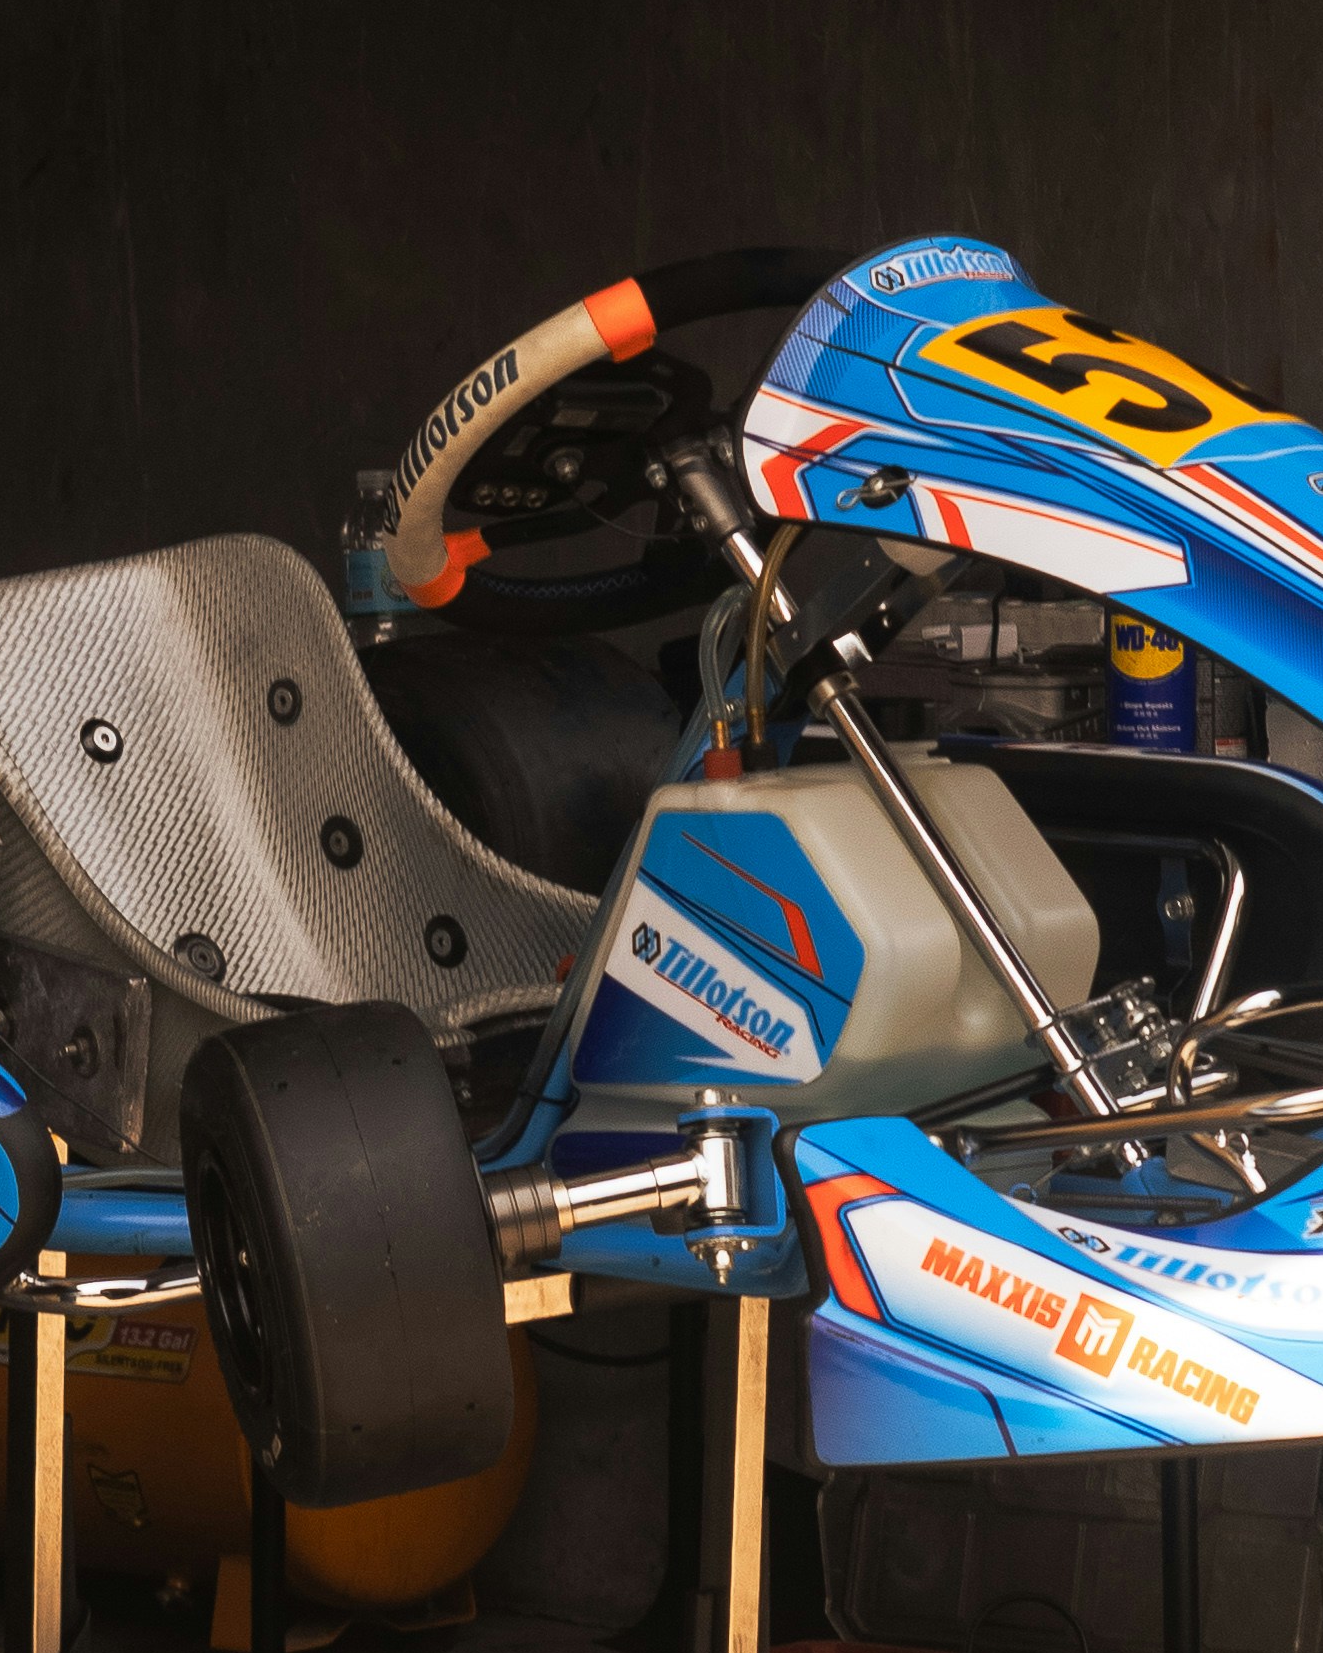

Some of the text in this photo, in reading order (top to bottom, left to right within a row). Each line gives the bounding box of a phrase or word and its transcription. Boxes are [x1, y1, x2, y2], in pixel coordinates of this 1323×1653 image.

[898, 249, 1009, 284] Tillotson
[655, 935, 795, 1049] Tillotson
[920, 1238, 1261, 1426] MAXXIS RACING
